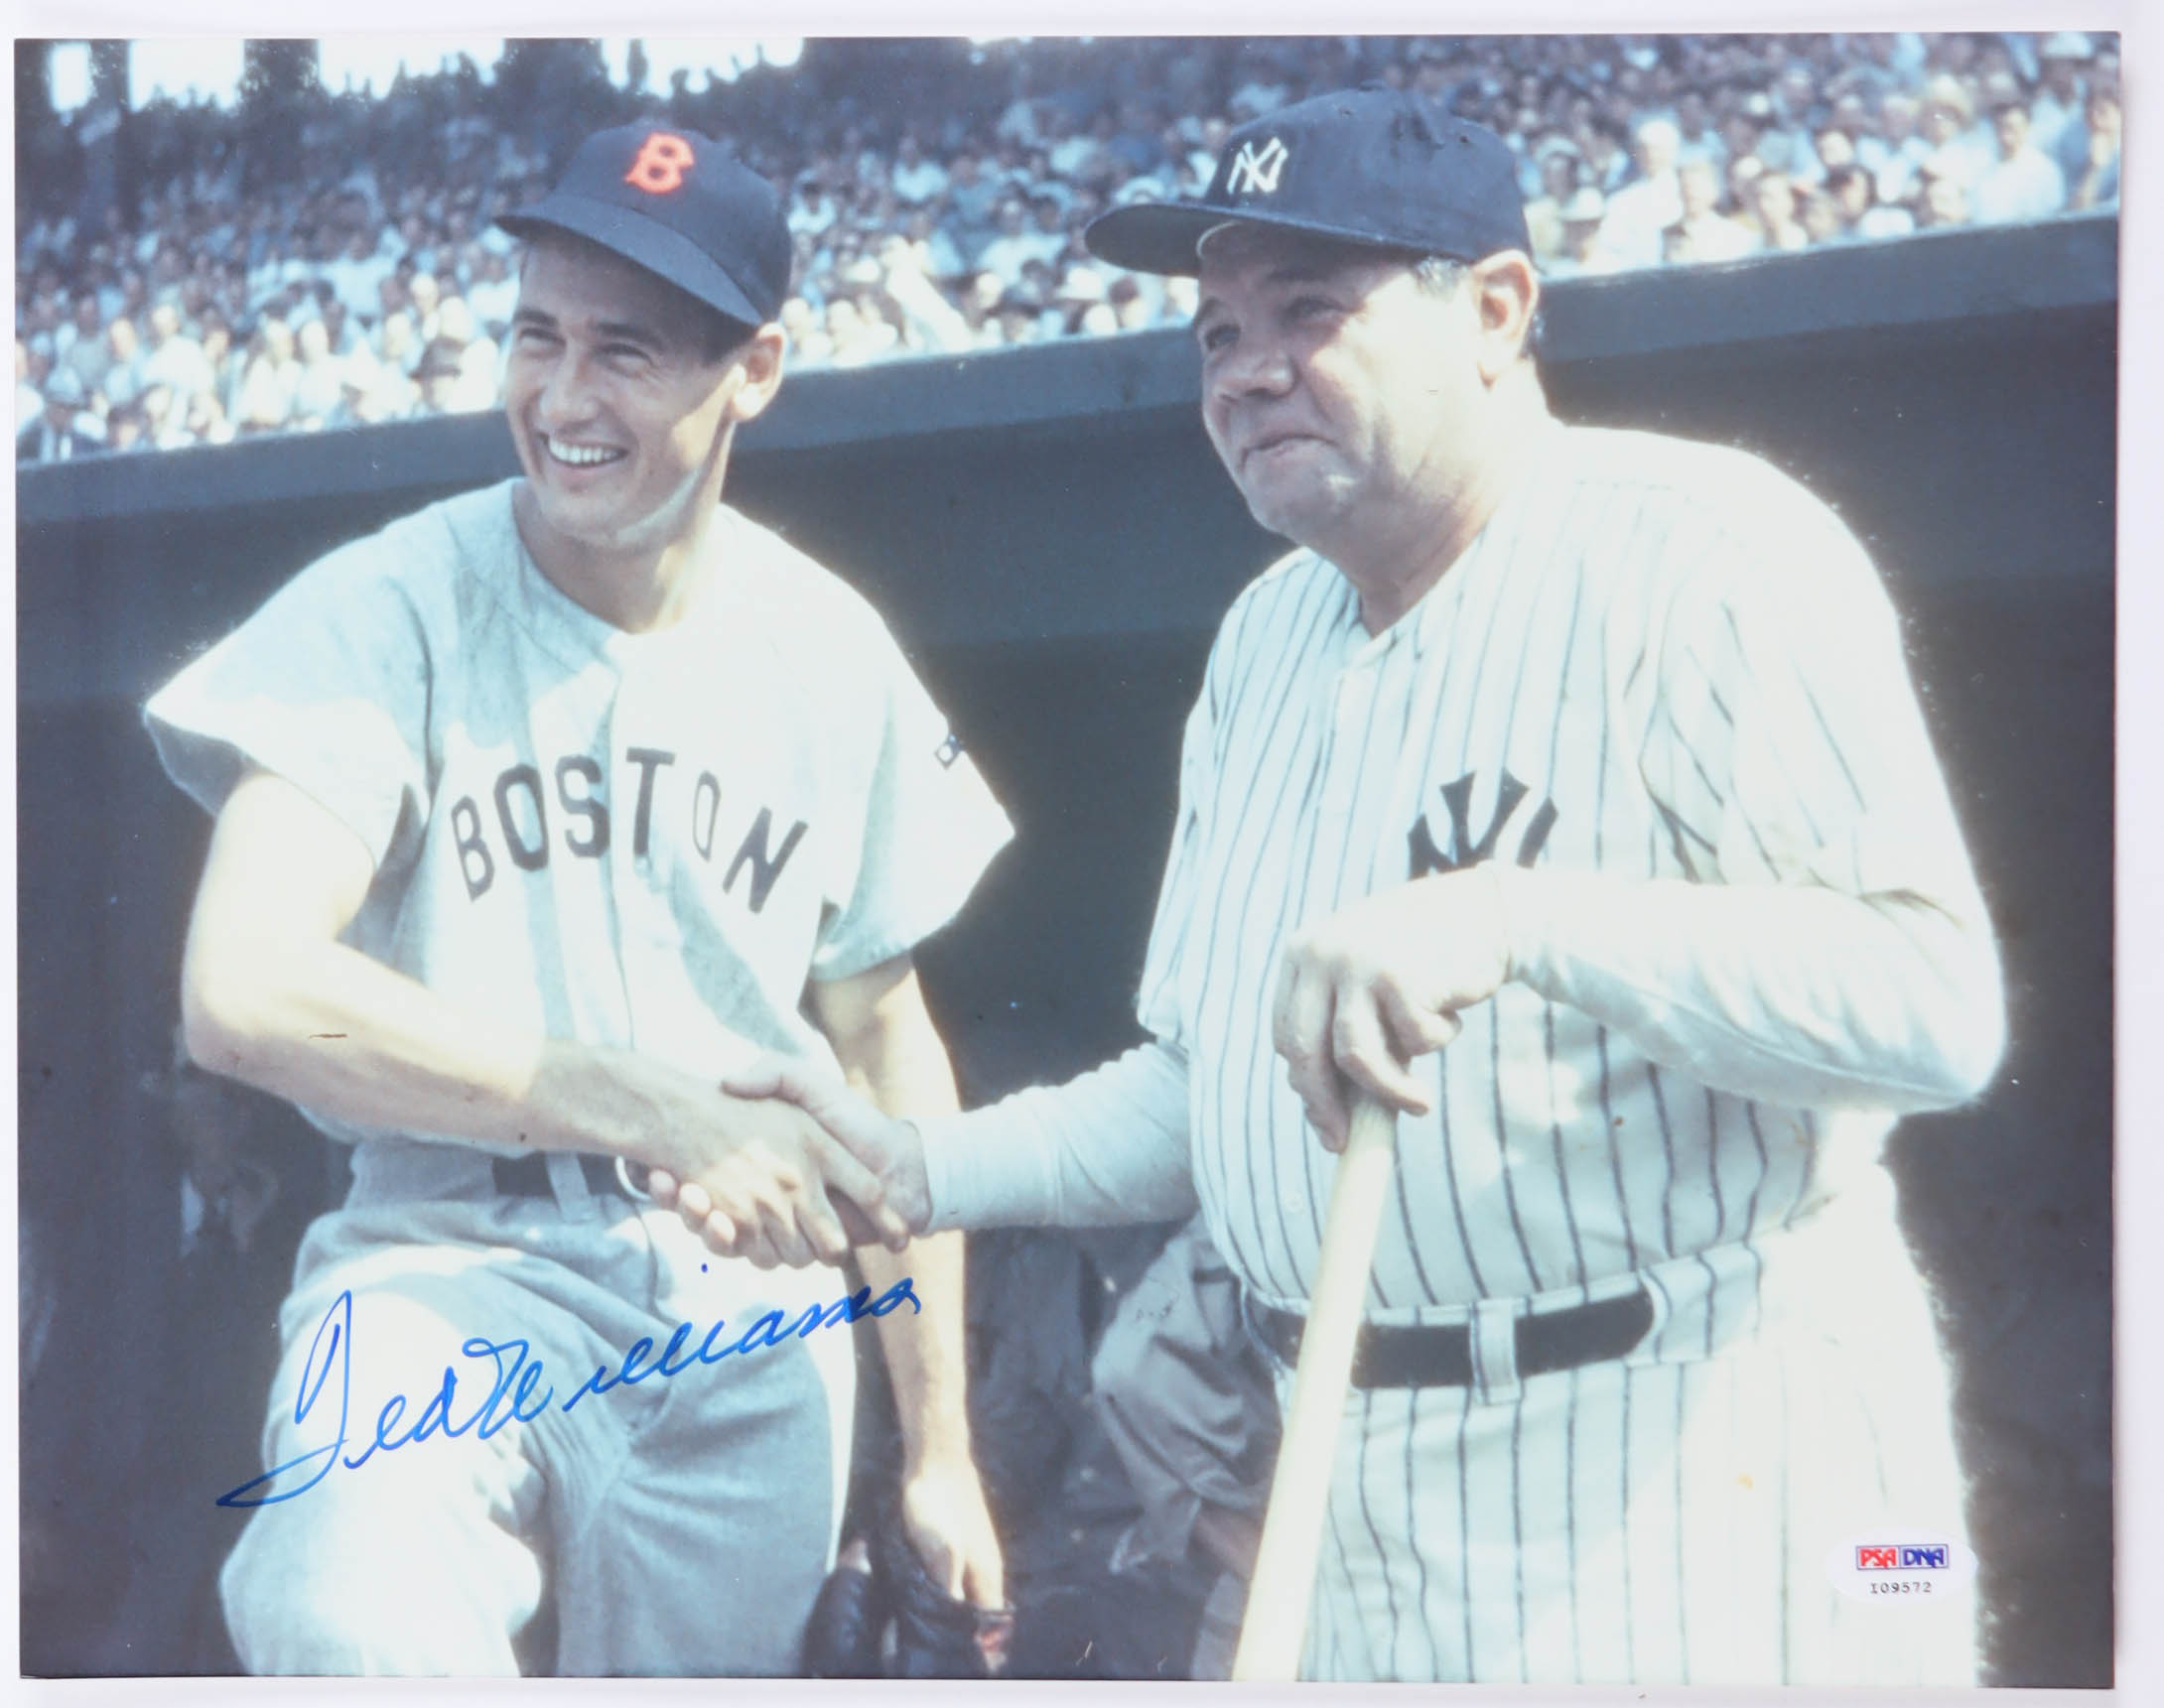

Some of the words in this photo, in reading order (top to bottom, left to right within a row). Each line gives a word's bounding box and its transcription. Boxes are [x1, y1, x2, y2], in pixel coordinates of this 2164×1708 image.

[623, 132, 695, 194] B
[1226, 137, 1288, 195] NY
[451, 746, 809, 914] BOSTON
[215, 1289, 463, 1508] Ted
[462, 1263, 922, 1440] Williams
[1859, 1547, 1897, 1568] PSA
[1903, 1547, 1945, 1568] DNA
